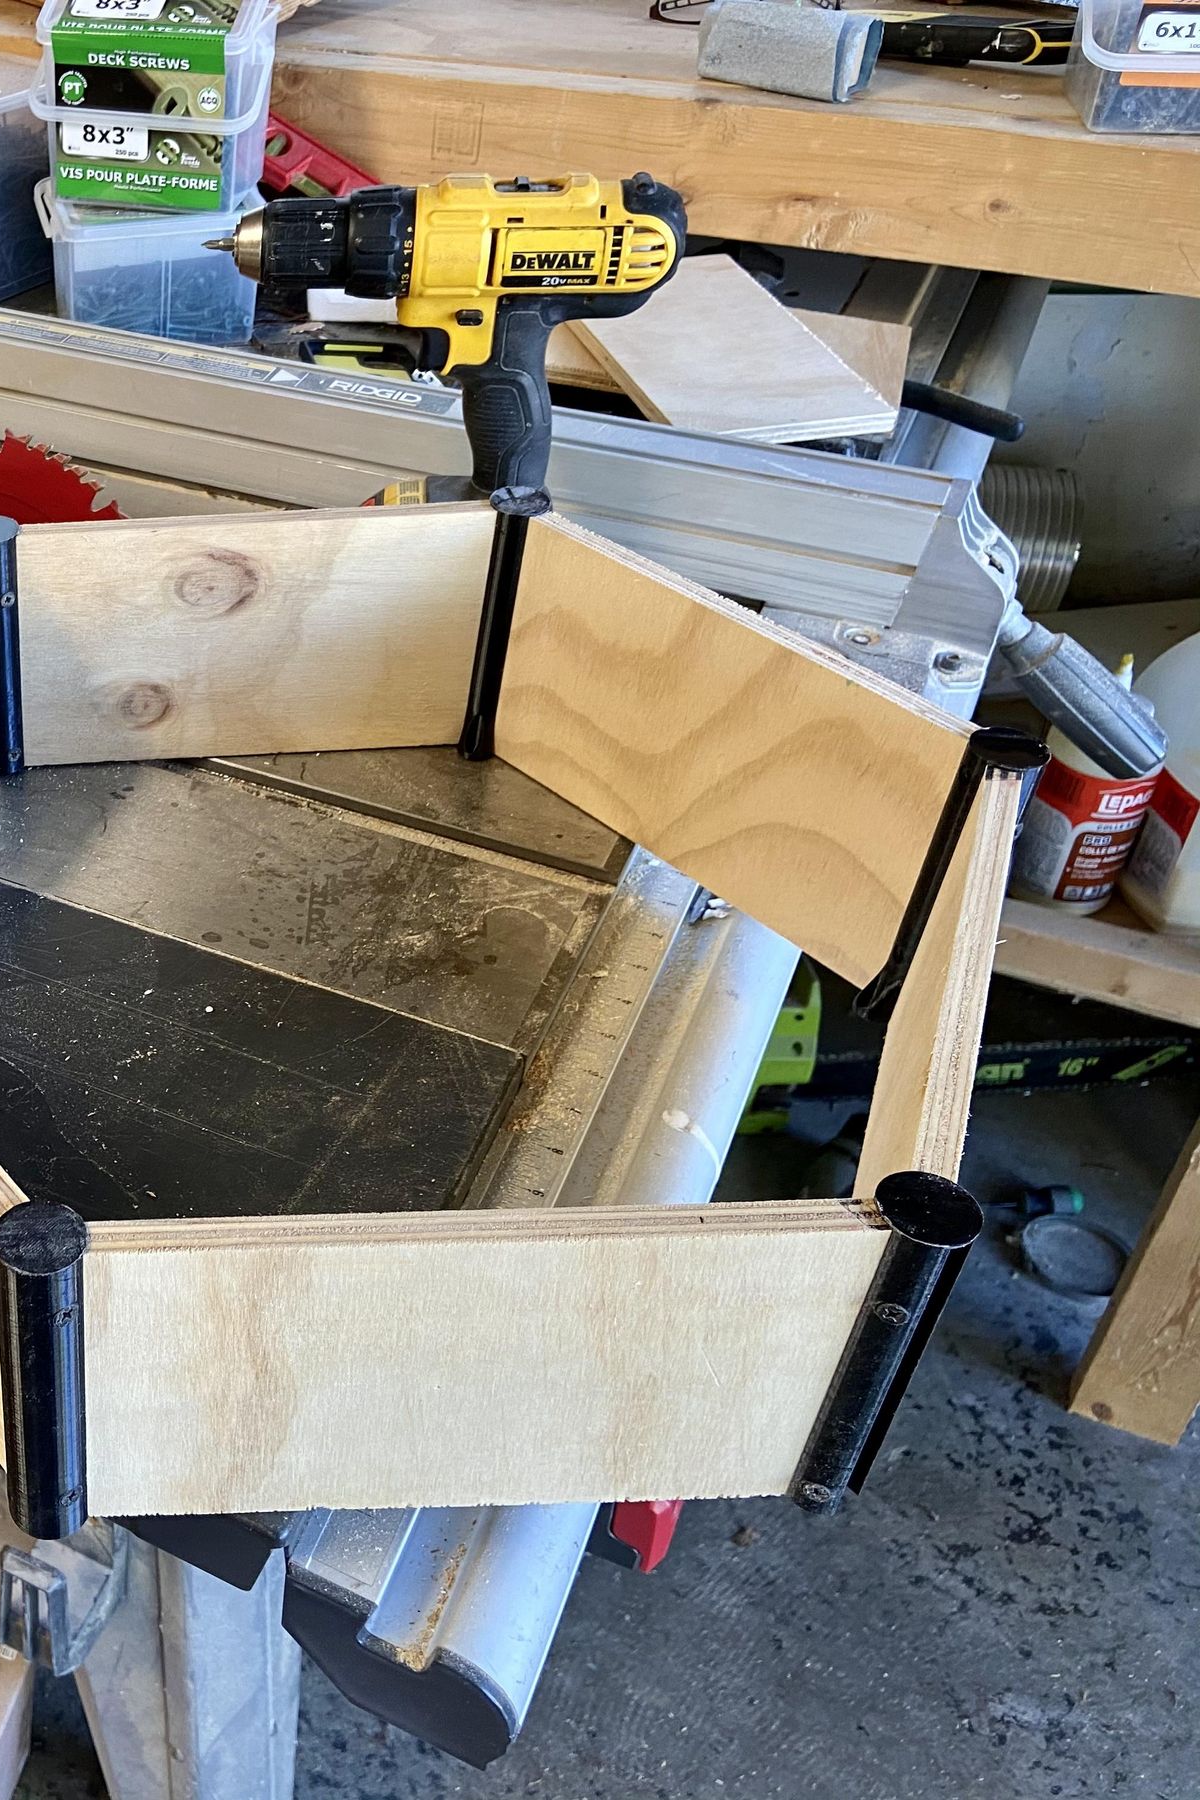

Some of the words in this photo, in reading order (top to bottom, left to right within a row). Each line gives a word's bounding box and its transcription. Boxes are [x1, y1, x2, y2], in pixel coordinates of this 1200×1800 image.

[1155, 21, 1200, 39] 6x1
[87, 53, 126, 67] DECK
[128, 55, 190, 71] SCREWS
[64, 81, 82, 95] PT
[82, 124, 134, 145] 8x3"
[60, 166, 83, 180] VIS
[86, 169, 123, 184] POUR
[126, 174, 218, 192] PLATE-FORME
[328, 379, 423, 404] RIDGID
